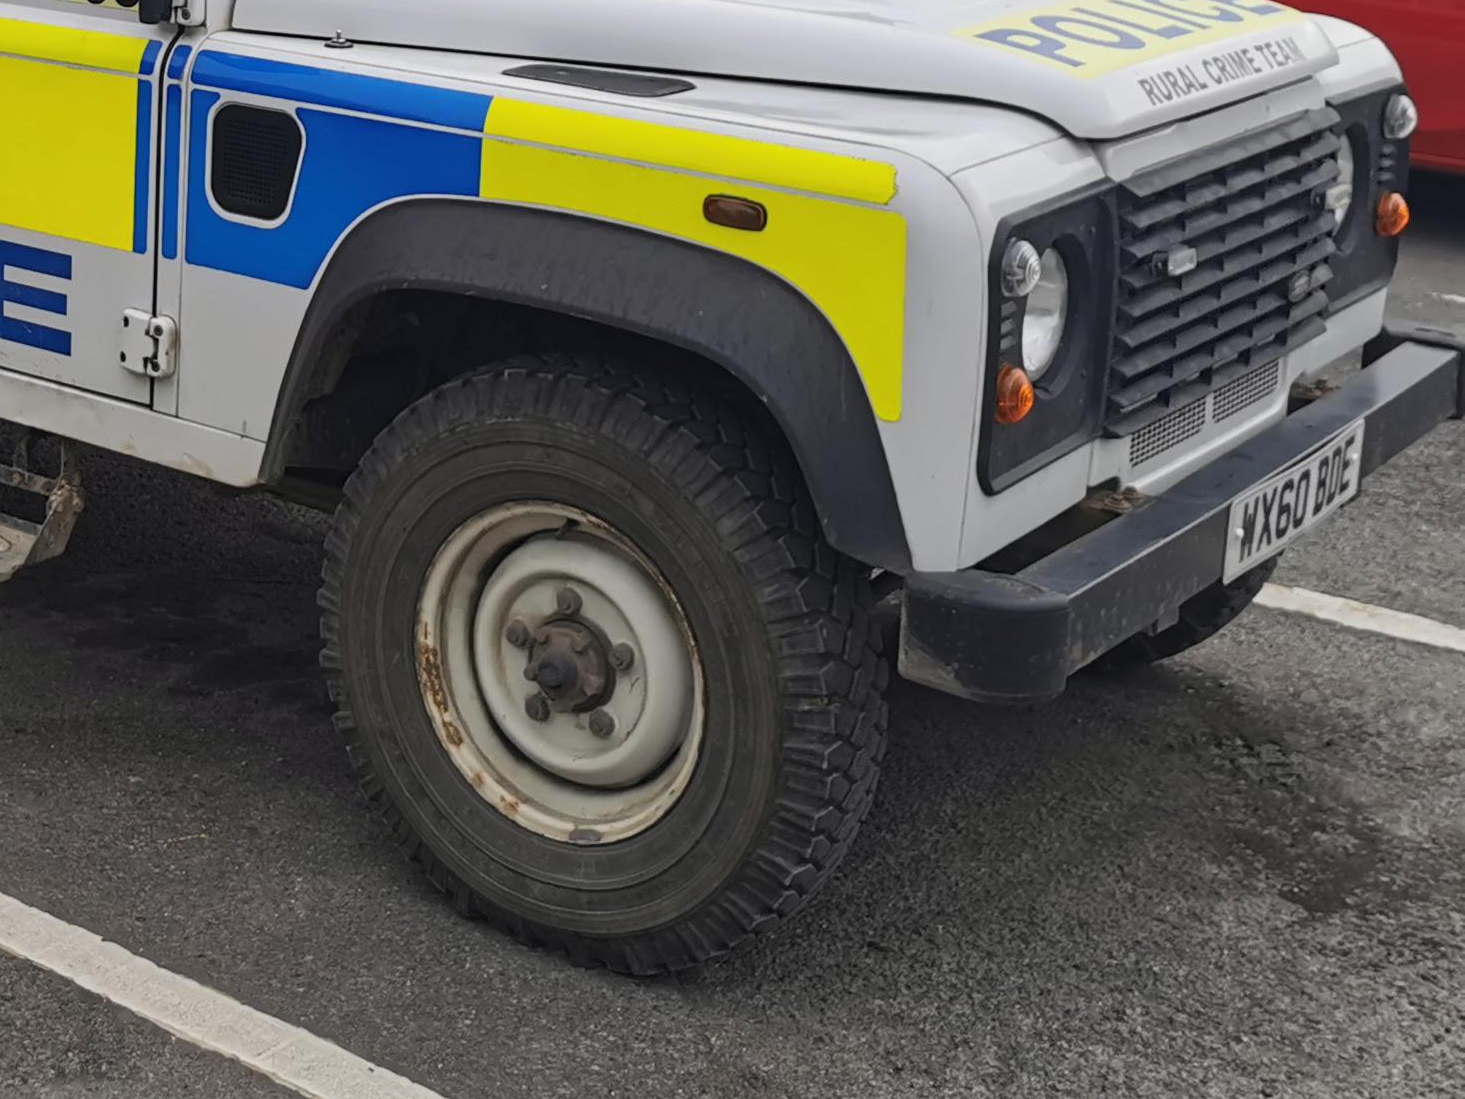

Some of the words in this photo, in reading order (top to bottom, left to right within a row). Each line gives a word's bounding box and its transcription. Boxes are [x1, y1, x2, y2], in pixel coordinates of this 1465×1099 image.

[1137, 64, 1209, 106] RURAL
[1201, 47, 1263, 86] CRIME
[1253, 36, 1308, 70] TEAM
[1238, 468, 1311, 563] WX60
[1312, 435, 1356, 517] BDE
